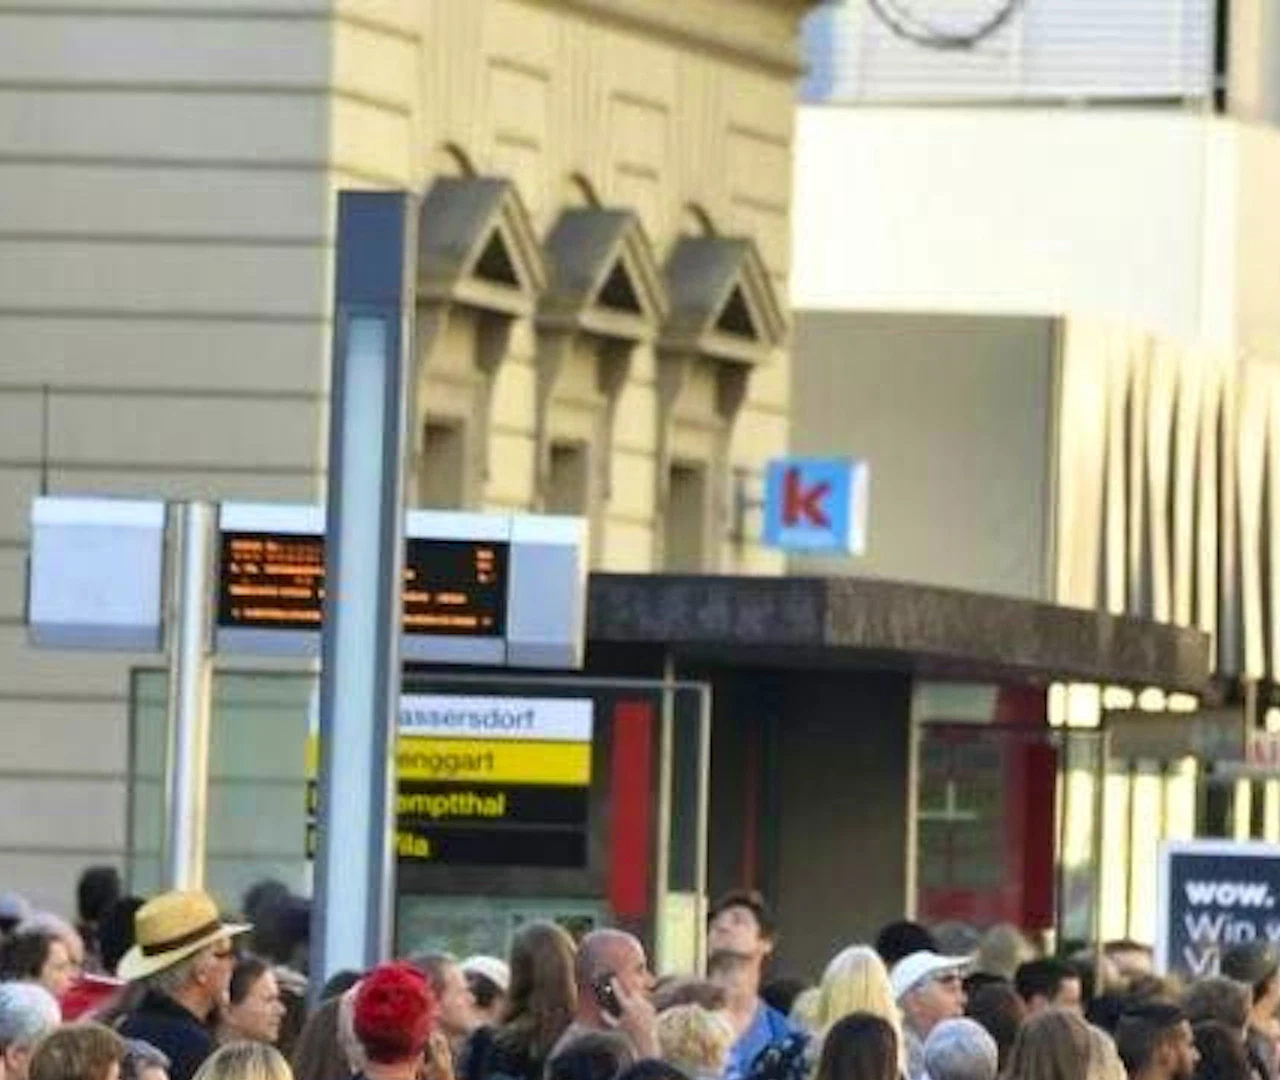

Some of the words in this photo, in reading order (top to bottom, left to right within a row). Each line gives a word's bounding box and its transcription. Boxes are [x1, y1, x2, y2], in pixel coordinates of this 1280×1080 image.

[401, 708, 536, 730] assersdorf
[397, 750, 496, 773] enggart
[397, 792, 506, 817] emptthal
[396, 833, 430, 857] ila
[1185, 882, 1275, 908] wow.
[1185, 912, 1257, 942] Win
